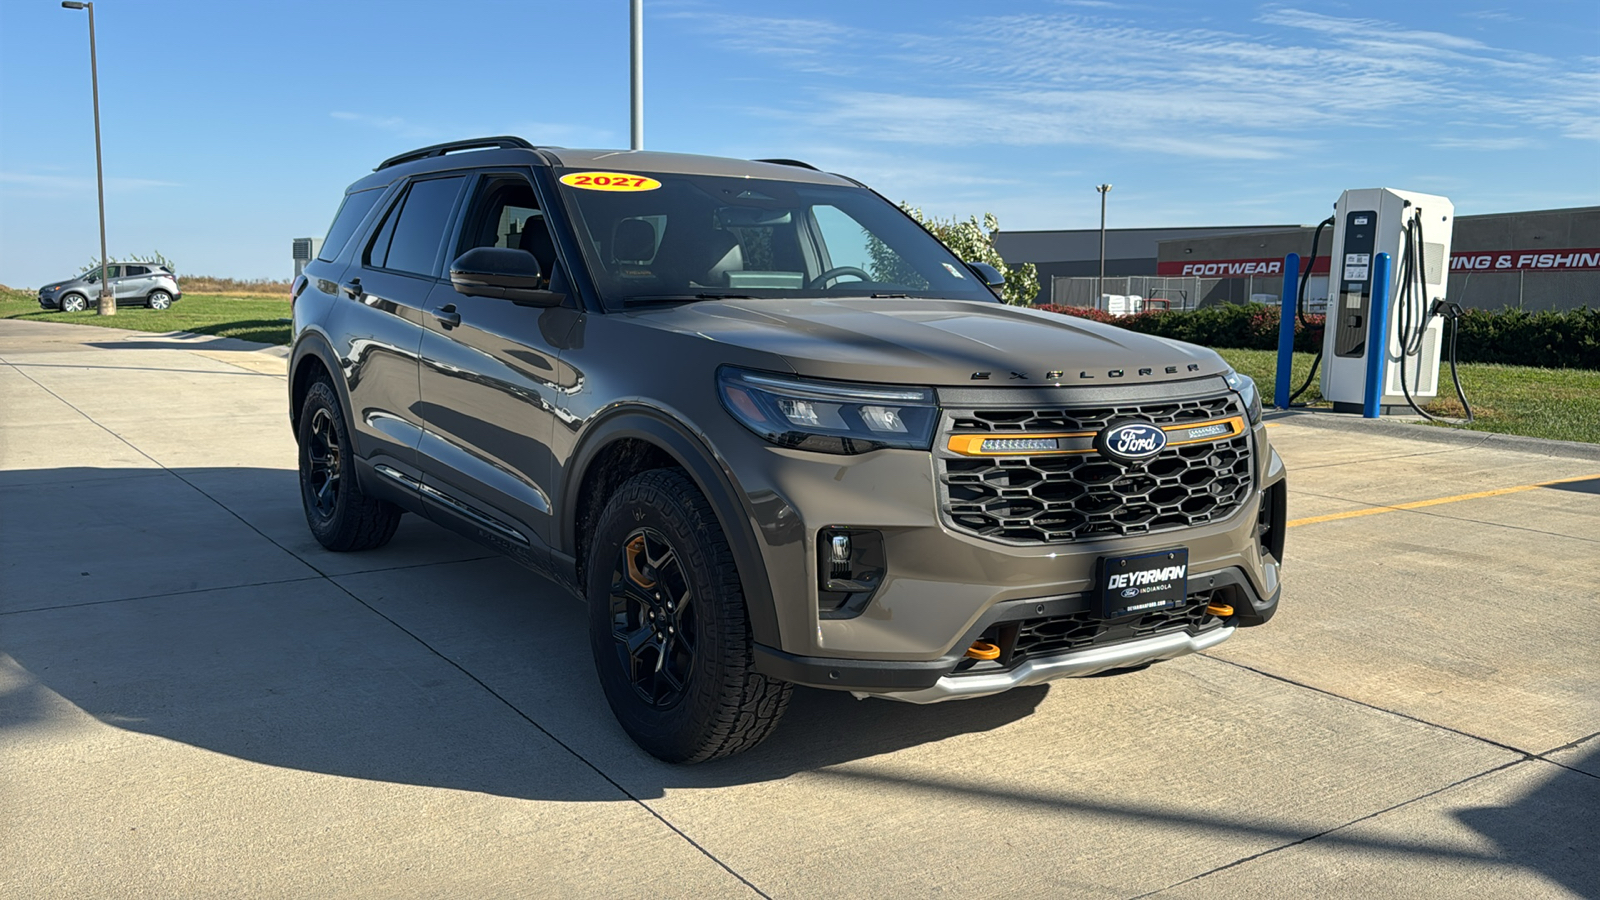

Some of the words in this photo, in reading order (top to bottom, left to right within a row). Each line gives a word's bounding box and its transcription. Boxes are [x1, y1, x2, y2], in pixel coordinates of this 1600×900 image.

[574, 176, 648, 187] 2027
[1182, 262, 1281, 276] FOOTWEAR
[1450, 255, 1492, 270] ING
[1495, 255, 1512, 269] &
[1516, 252, 1600, 269] FISHIN
[971, 363, 1199, 380] EXPLORER
[1117, 428, 1157, 452] Ford
[1108, 565, 1186, 589] DEYARMAN
[1140, 584, 1171, 593] INDIANOLA
